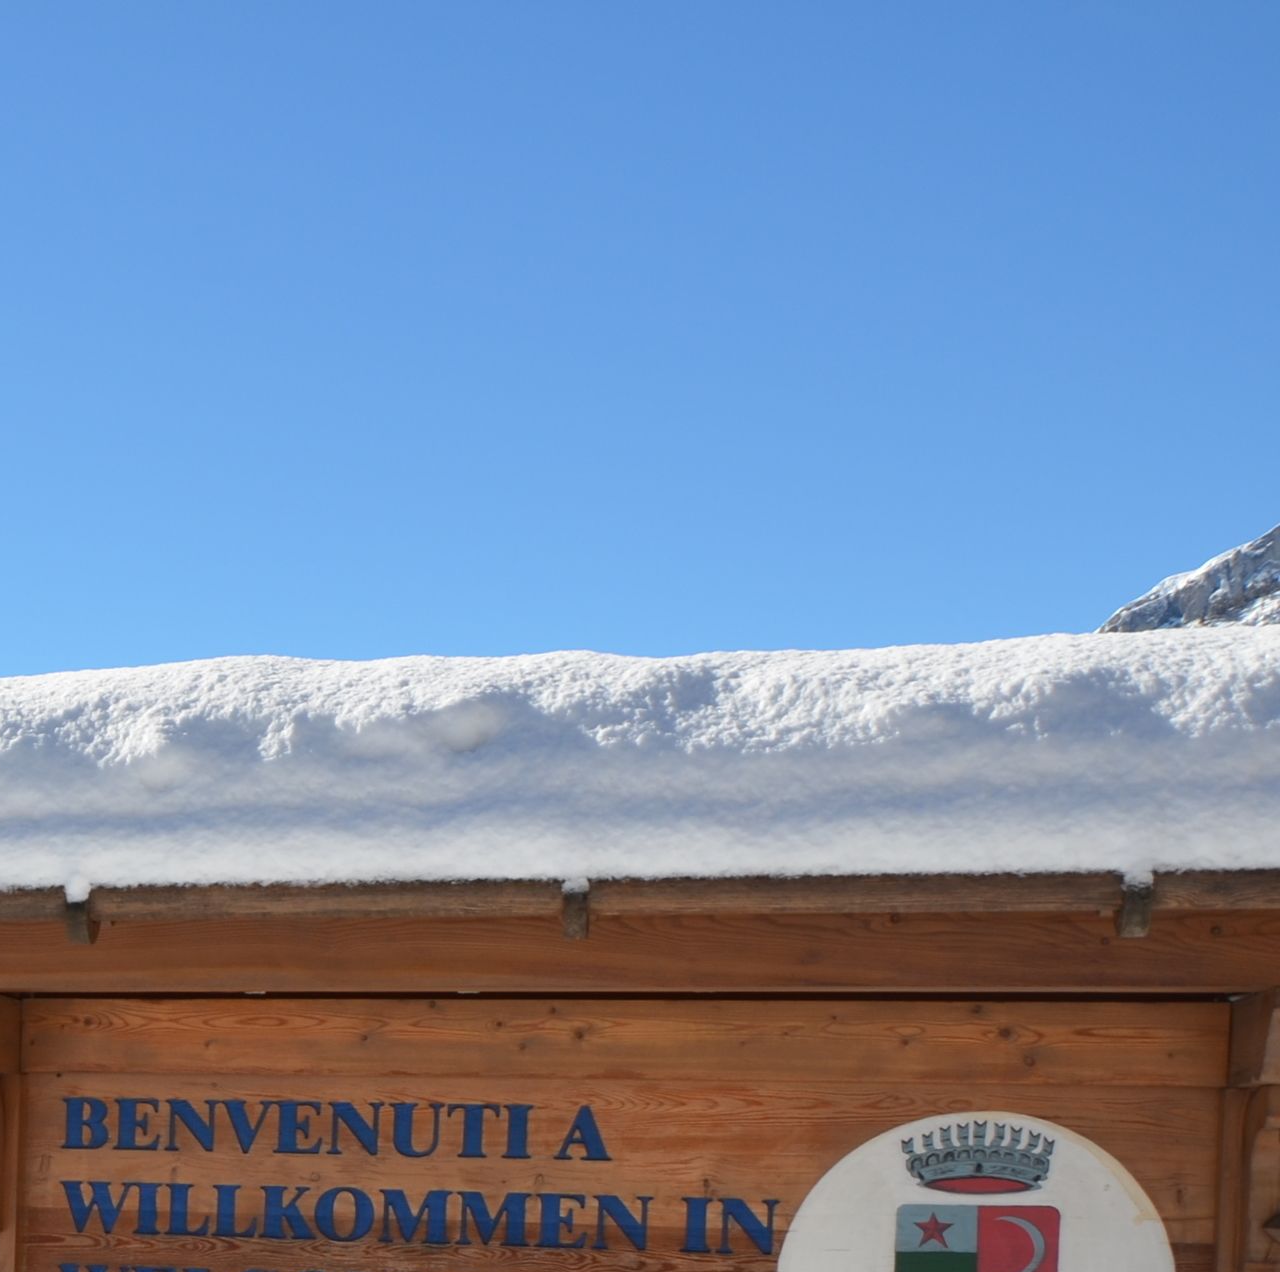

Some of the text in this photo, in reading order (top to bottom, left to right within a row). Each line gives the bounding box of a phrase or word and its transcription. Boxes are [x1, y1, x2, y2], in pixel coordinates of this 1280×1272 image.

[61, 1097, 612, 1161] BENVENUTI A
[60, 1180, 780, 1254] WILLKOMMEN IN
